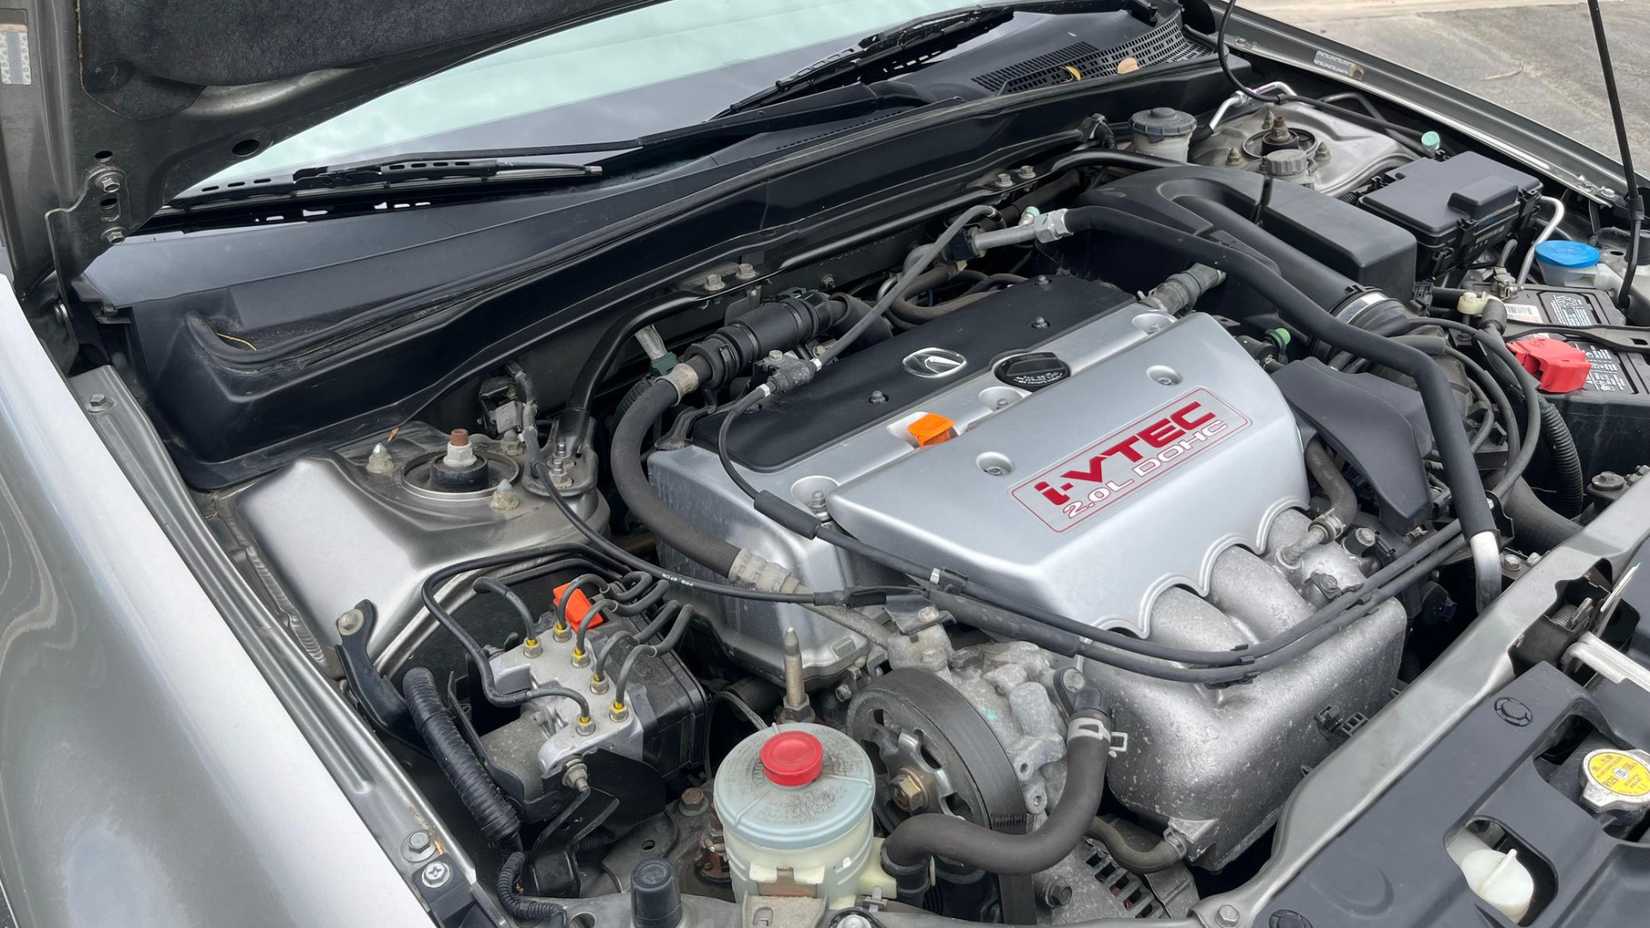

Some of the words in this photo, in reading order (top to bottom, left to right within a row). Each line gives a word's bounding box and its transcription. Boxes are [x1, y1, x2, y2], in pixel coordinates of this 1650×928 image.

[1035, 401, 1216, 505] i-VTEC
[1063, 477, 1135, 519] 2.0L
[1133, 420, 1227, 477] DOHC
